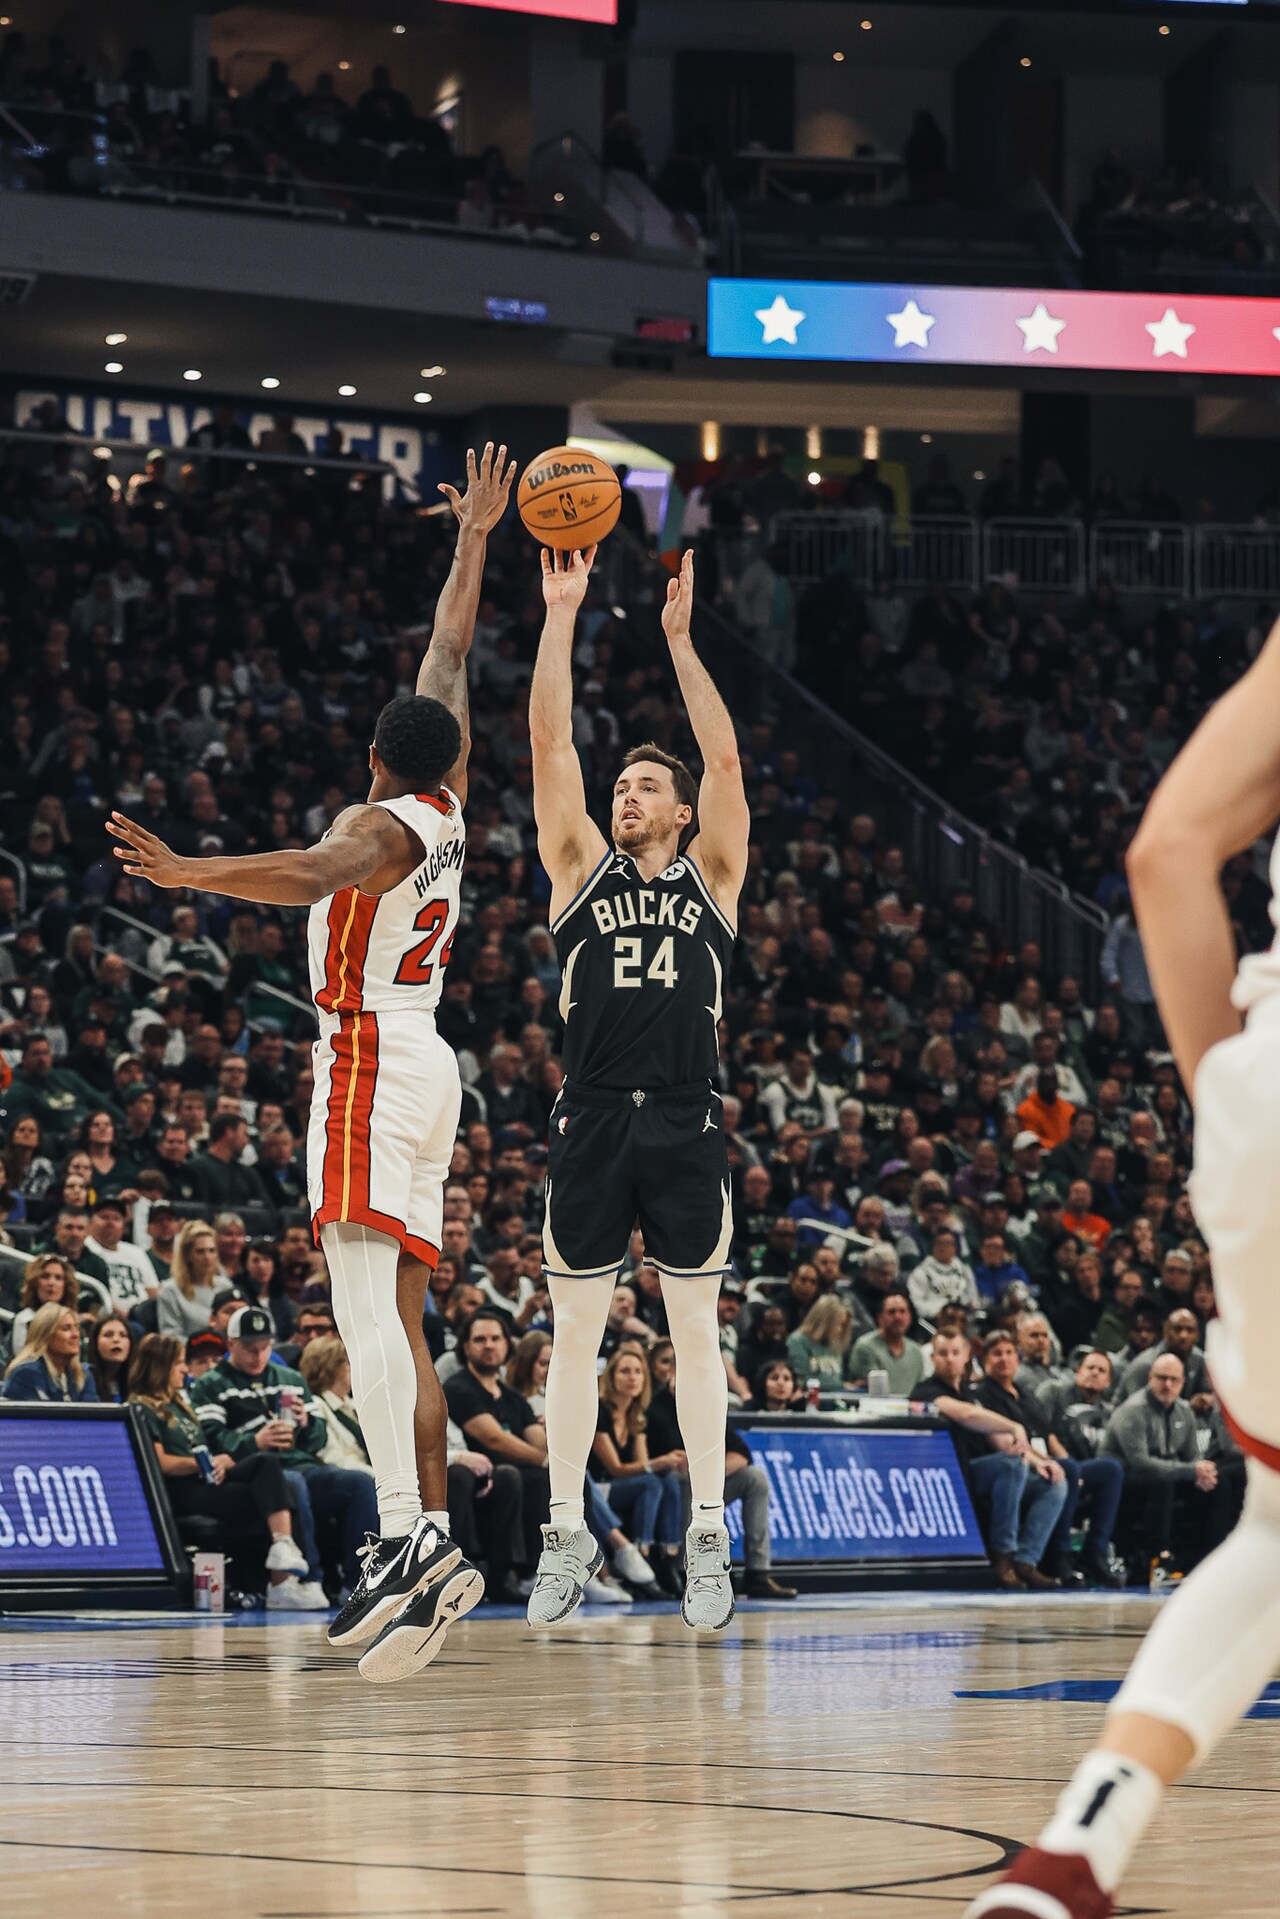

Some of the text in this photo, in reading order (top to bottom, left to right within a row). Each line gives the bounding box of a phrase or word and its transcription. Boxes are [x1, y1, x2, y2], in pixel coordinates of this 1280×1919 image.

[527, 463, 596, 490] Wilson
[591, 889, 704, 936] BUCKS
[613, 936, 679, 988] 24
[724, 1449, 967, 1542] ATickets.com
